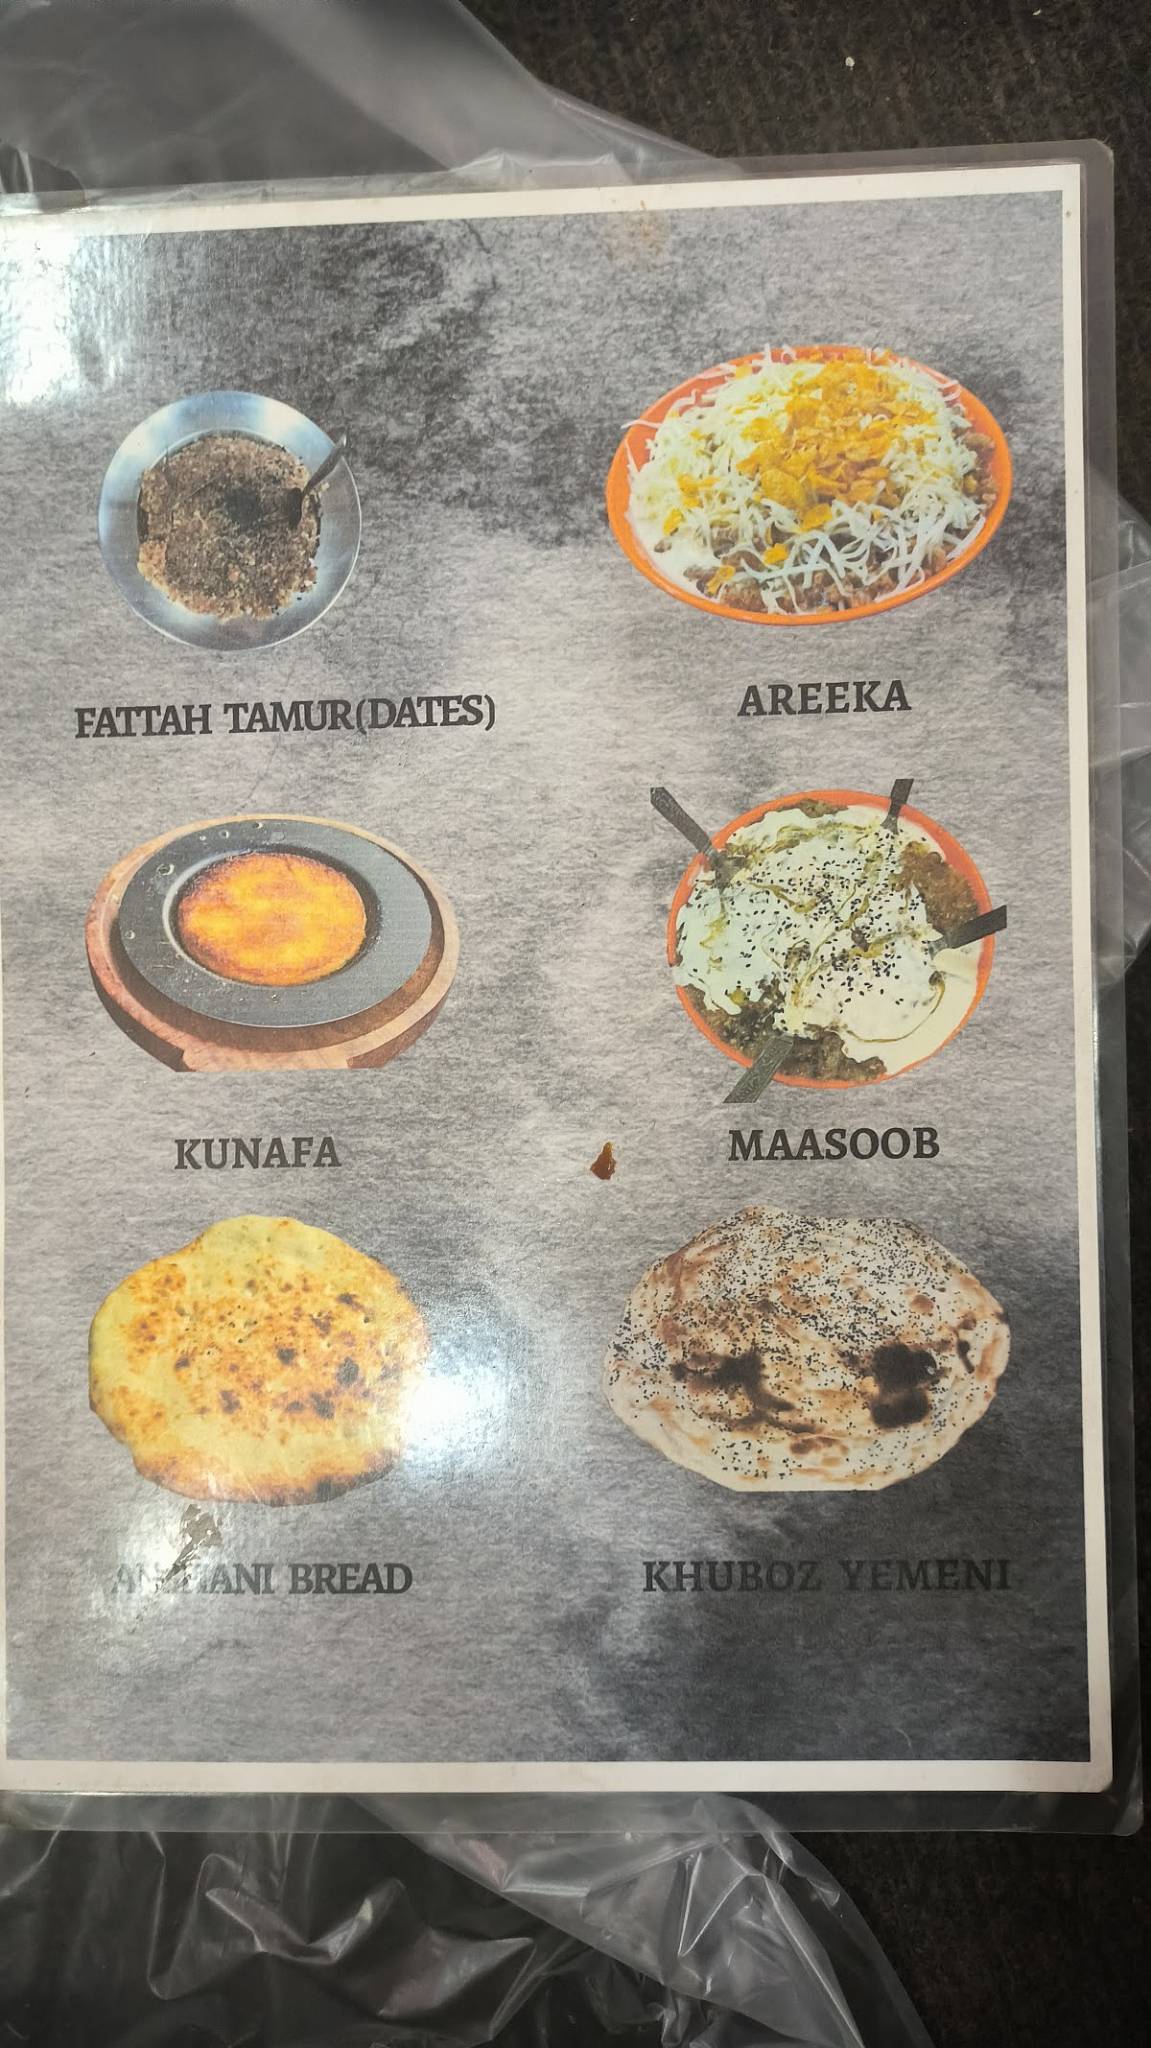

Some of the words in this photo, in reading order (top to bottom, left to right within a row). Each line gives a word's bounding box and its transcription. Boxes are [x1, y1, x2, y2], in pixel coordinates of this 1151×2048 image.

[737, 679, 912, 717] AREEKA
[74, 703, 213, 739] FATTAH
[223, 694, 496, 734] TAMUR(DATES)
[174, 1136, 342, 1170] KUNAFA
[728, 1127, 940, 1161] MAASOOB
[288, 1562, 413, 1595] BREAD
[642, 1560, 823, 1593] KHUBOZ
[838, 1558, 1012, 1592] YEMENI
